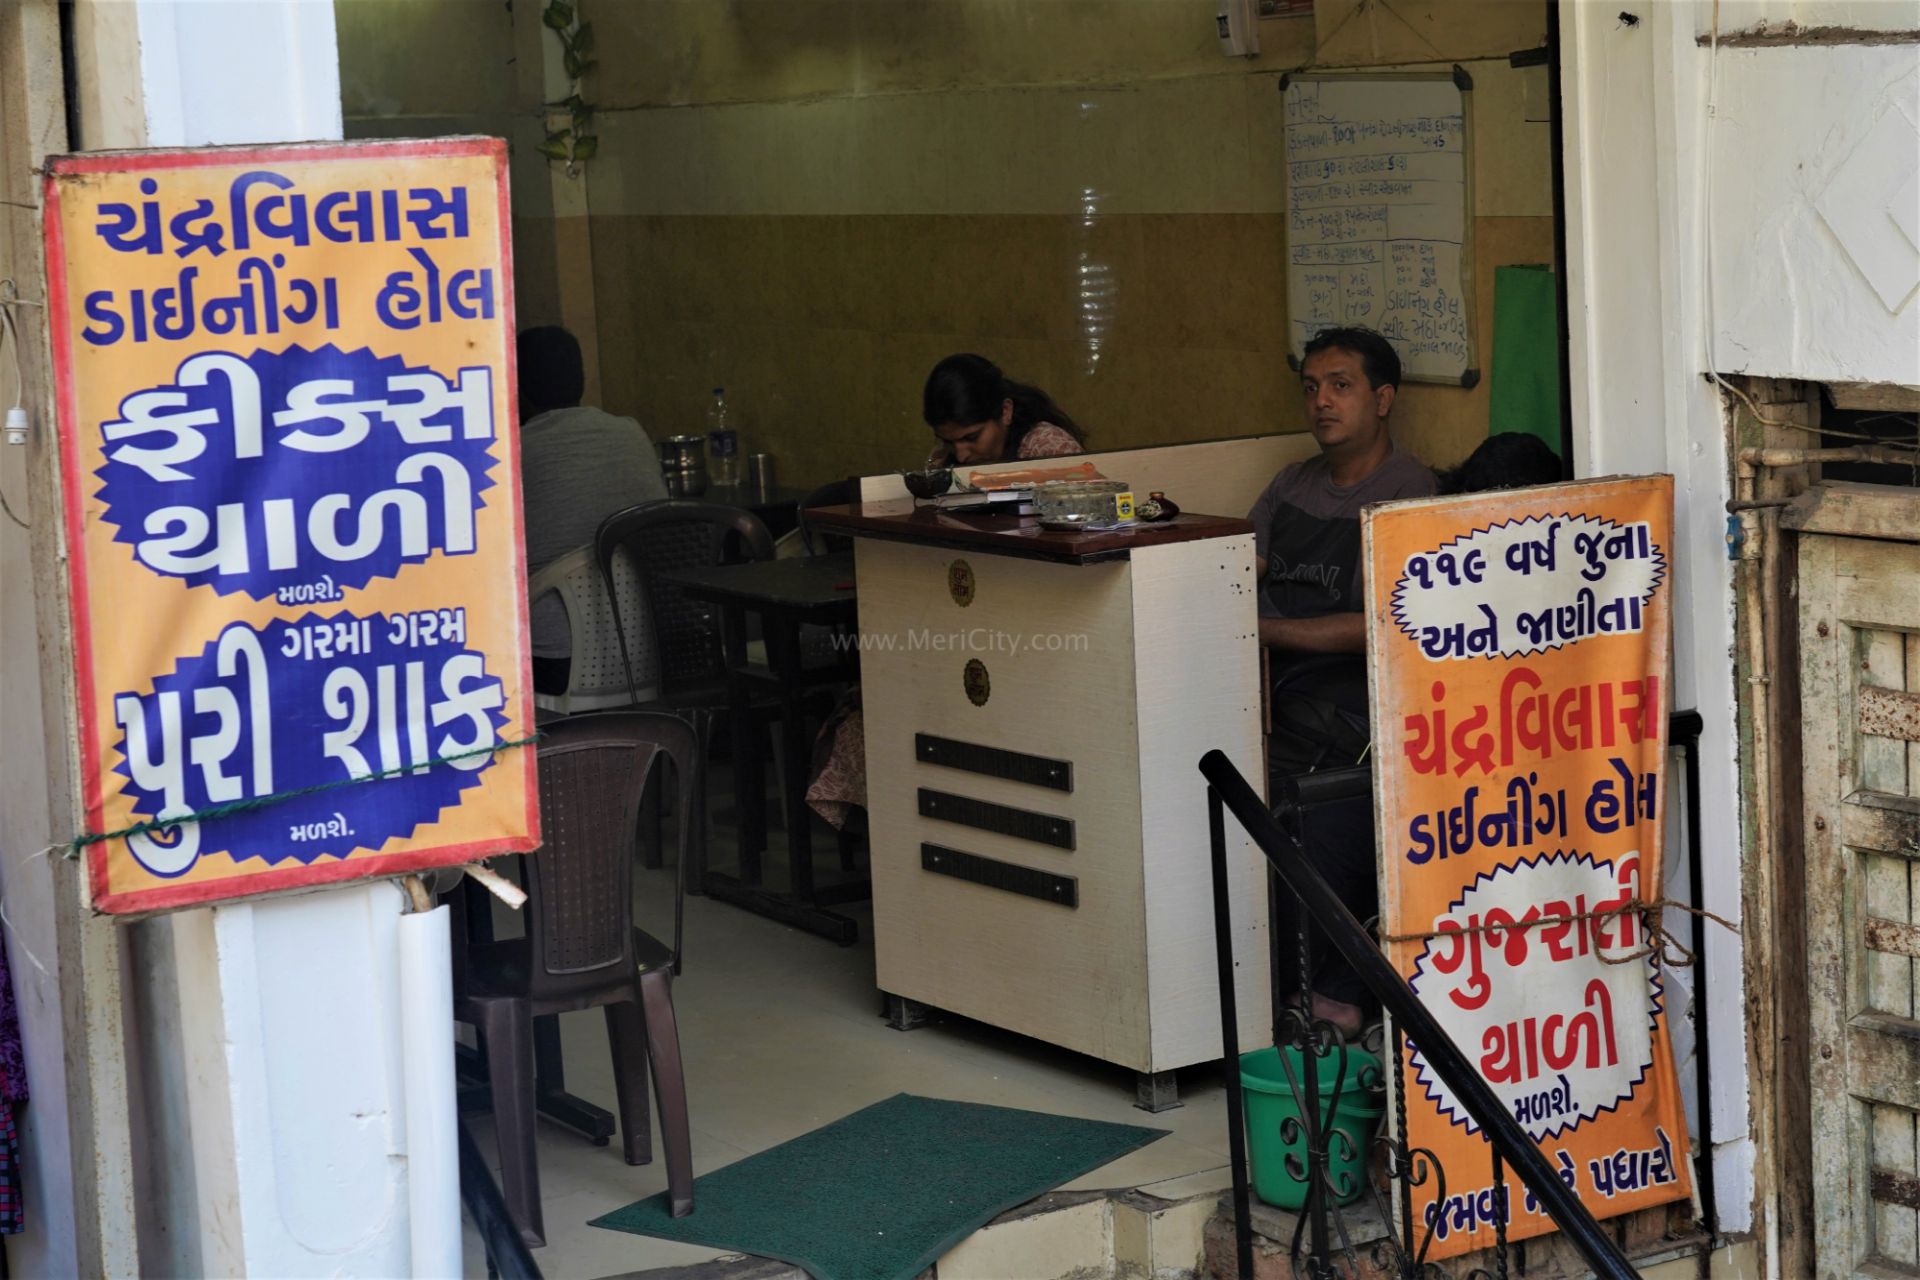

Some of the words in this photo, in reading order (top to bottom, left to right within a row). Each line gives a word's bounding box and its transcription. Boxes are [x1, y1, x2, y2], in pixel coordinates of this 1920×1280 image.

[96, 170, 470, 259] ચંદ્રવિલાસ
[81, 253, 340, 346] ડાઈનીંગ
[375, 247, 496, 330] હોલ
[138, 453, 476, 575] થાળી
[1408, 547, 1487, 590] ૧૧૯
[1504, 521, 1562, 576] વર્ષ
[1573, 524, 1650, 582] જુના
[277, 574, 343, 605] મળશે.
[1420, 603, 1499, 659] અને
[1515, 586, 1642, 646] જાણીતા
[280, 619, 372, 661] ગરમા
[387, 608, 467, 648] ગરમ
[322, 654, 503, 784] શાક
[1403, 667, 1659, 779] ચંદ્રવિલાસ
[289, 813, 356, 844] મળશે.
[1406, 771, 1568, 866] ડાઈનીંગ
[1431, 856, 1643, 1010] ગુજરાતી
[1480, 978, 1618, 1085] થાળી
[1514, 1074, 1579, 1125] મળશે.
[1590, 1127, 1677, 1197] પધારો
